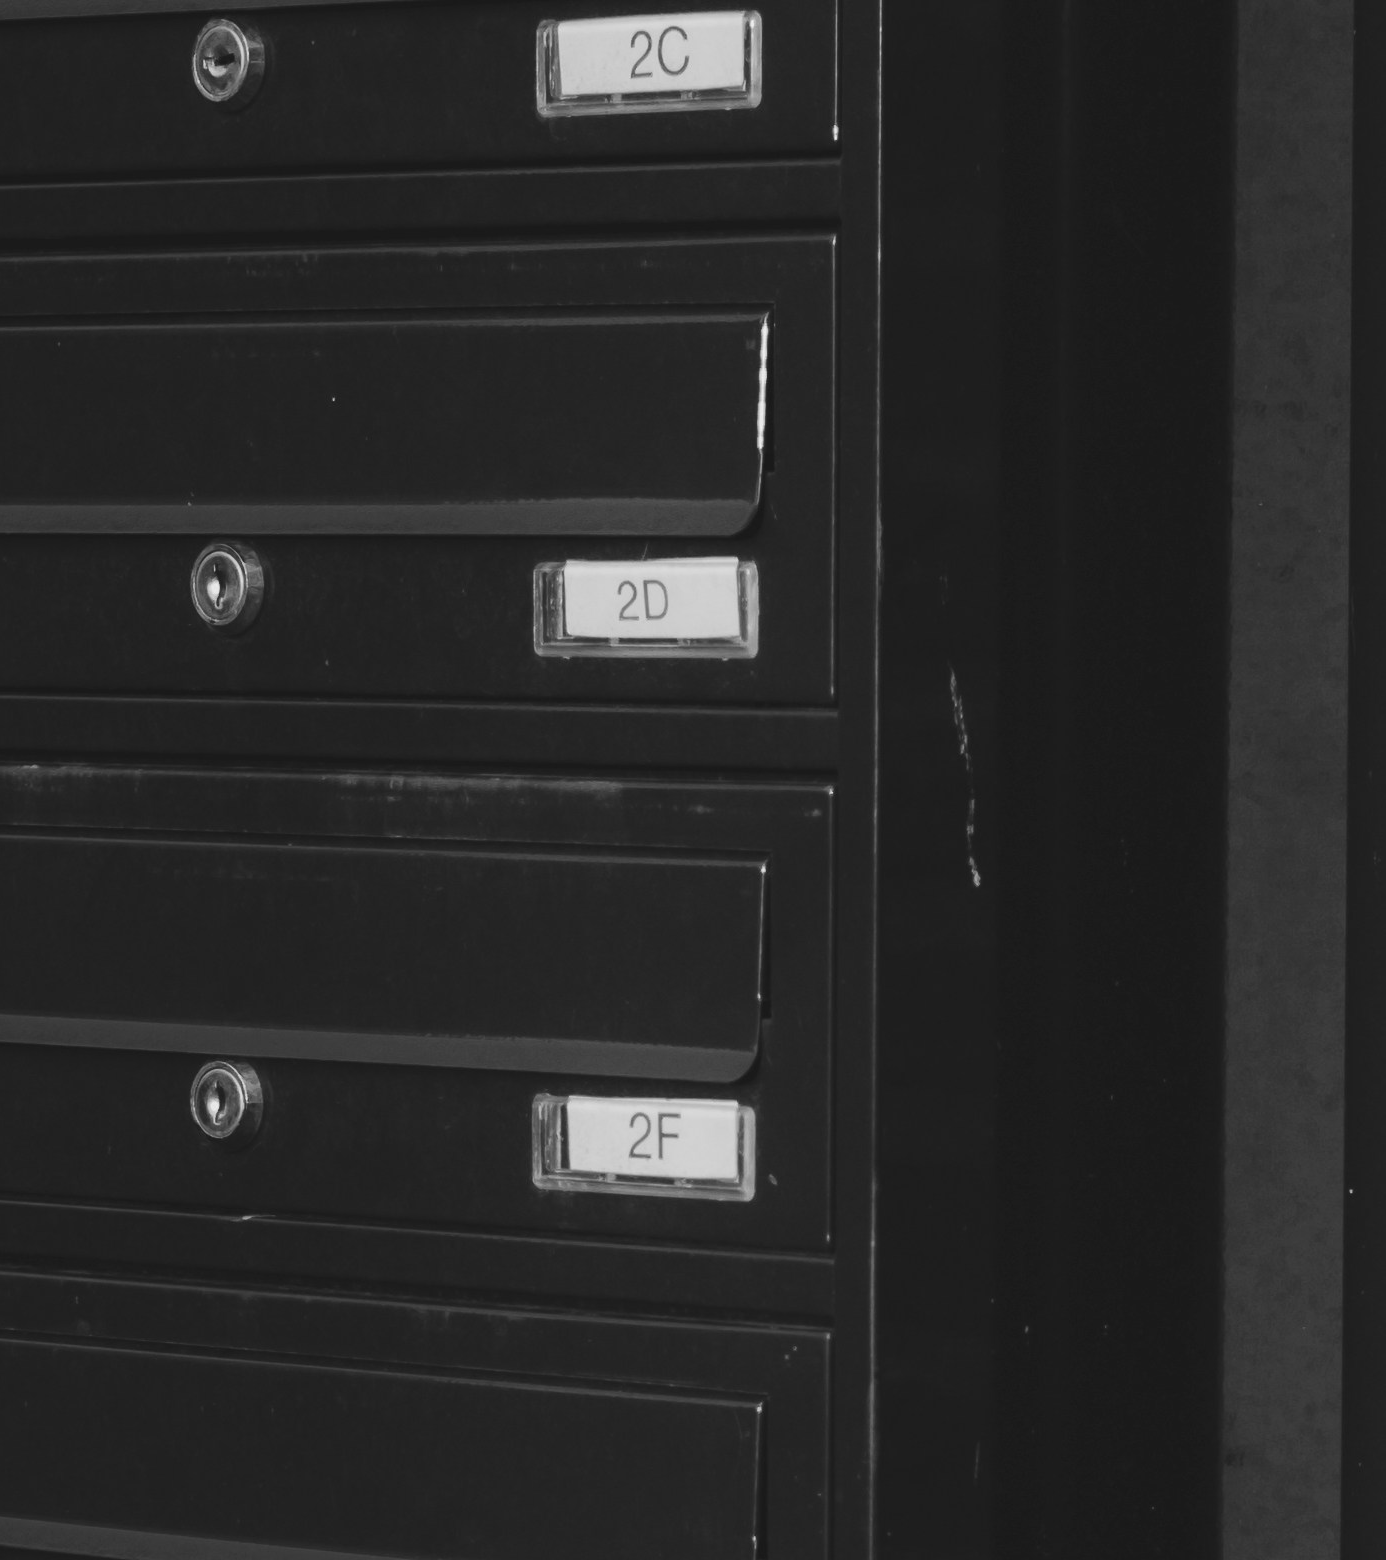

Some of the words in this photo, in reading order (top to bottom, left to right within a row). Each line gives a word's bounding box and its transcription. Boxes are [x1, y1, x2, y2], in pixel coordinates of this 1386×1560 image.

[629, 25, 690, 80] 2C
[616, 579, 670, 622] 2D
[627, 1111, 682, 1161] 2F
